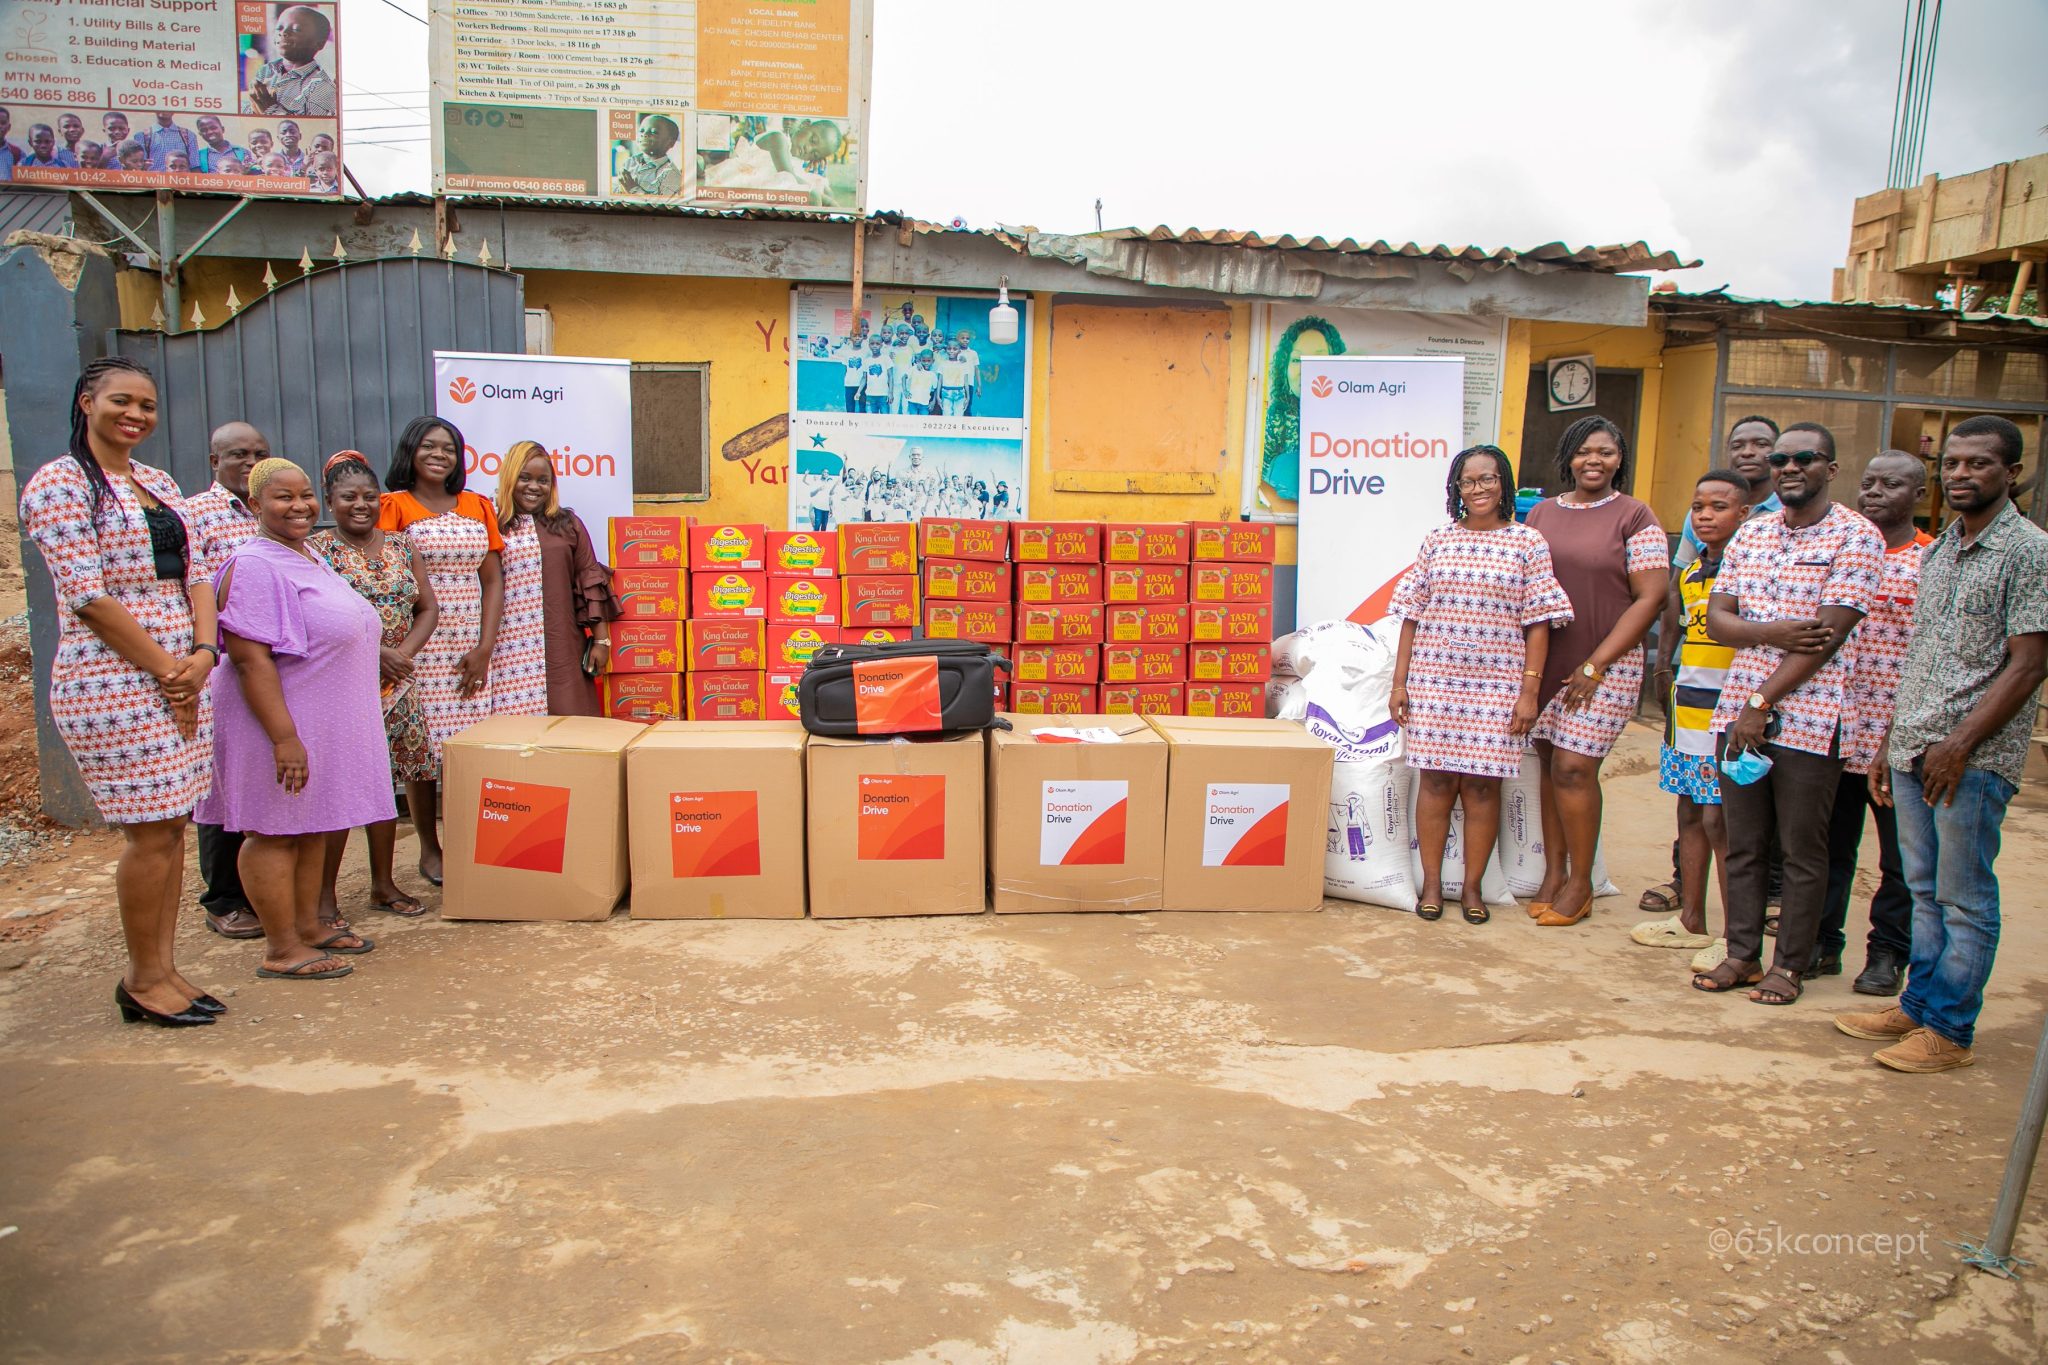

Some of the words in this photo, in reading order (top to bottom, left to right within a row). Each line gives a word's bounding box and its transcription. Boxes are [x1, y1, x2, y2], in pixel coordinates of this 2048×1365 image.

[151, 0, 217, 12] Support
[243, 4, 261, 13] God
[749, 8, 774, 17] LOCAL
[776, 9, 800, 17] BANK
[240, 14, 264, 23] Bless
[68, 16, 79, 27] 1.
[83, 17, 121, 30] Utility
[125, 20, 153, 31] Bills
[157, 22, 166, 32] &
[170, 22, 201, 33] Care
[243, 24, 262, 33] You!
[457, 21, 489, 30] Workers
[490, 23, 527, 32] Bedrooms
[68, 35, 80, 45] 2.
[84, 36, 138, 51] Building
[143, 39, 196, 51] Material
[5, 52, 58, 64] Chosen
[457, 48, 471, 57] Boy
[474, 49, 512, 59] Dormitory
[518, 51, 540, 59] Room
[70, 54, 82, 64] 3.
[86, 54, 153, 68] Education
[156, 59, 166, 69] &
[170, 59, 221, 71] Medical
[742, 60, 804, 70] INTERNATIONAL
[5, 71, 35, 82] MTN
[39, 73, 81, 85] Momo
[458, 76, 494, 84] Assemble
[496, 77, 513, 86] Hall
[132, 78, 203, 91] Voda-Cash
[33, 88, 63, 101] 865
[67, 90, 97, 103] 886
[458, 89, 487, 97] Kitchen
[498, 91, 542, 100] Equipments
[118, 93, 157, 106] 0203
[162, 95, 187, 107] 161
[194, 97, 222, 109] 555
[614, 112, 631, 120] God
[612, 121, 634, 129] Bless
[614, 131, 632, 139] You!
[17, 168, 69, 181] Matthew
[146, 174, 166, 185] will
[169, 175, 190, 186] Not
[194, 176, 224, 186] Lose
[227, 179, 254, 190] your
[256, 178, 306, 190] Reward!
[447, 177, 469, 187] Call
[476, 180, 511, 189] momo
[512, 180, 540, 190] 0540
[542, 182, 563, 192] 865
[564, 183, 585, 192] 886
[698, 189, 725, 199] More
[727, 191, 764, 201] Rooms
[766, 192, 777, 201] to
[778, 192, 808, 204] sleep
[1428, 336, 1454, 344] Founders
[1337, 380, 1375, 394] Olam
[1378, 381, 1406, 396] Agri
[482, 384, 527, 400] Olam
[531, 386, 564, 404] Agri
[806, 418, 844, 427] Donated
[848, 419, 859, 428] by
[961, 424, 1010, 432] Executives
[1310, 432, 1448, 458] Donation
[464, 443, 616, 476] Dotion
[1309, 468, 1385, 495] Drive
[625, 526, 643, 537] King
[644, 526, 671, 536] Cracker
[963, 530, 992, 540] TASTY
[1055, 532, 1084, 541] TASTY
[1232, 532, 1260, 541] TASTY
[710, 537, 749, 548] Digestive
[855, 532, 872, 543] King
[873, 532, 900, 542] Cracker
[1147, 534, 1175, 544] TASTY
[962, 538, 994, 553] TOM
[1054, 541, 1087, 555] TOM
[1145, 543, 1177, 558] TOM
[1231, 540, 1262, 555] TOM
[785, 591, 823, 602] Digestive
[1062, 614, 1090, 623] TASTY
[703, 630, 721, 641] King
[722, 630, 749, 640] Cracker
[1060, 623, 1092, 638] TOM
[858, 672, 904, 683] Donation
[859, 684, 885, 694] Drive
[1310, 722, 1343, 744] Royal
[1341, 741, 1389, 755] Aroma
[863, 793, 910, 803] Donation
[483, 797, 531, 813] Donation
[863, 805, 889, 815] Drive
[1047, 802, 1092, 812] Donation
[1210, 804, 1255, 814] Donation
[482, 809, 509, 822] Drive
[675, 811, 722, 821] Donation
[1046, 814, 1072, 823] Drive
[1209, 816, 1235, 825] Drive
[675, 823, 702, 833] Drive
